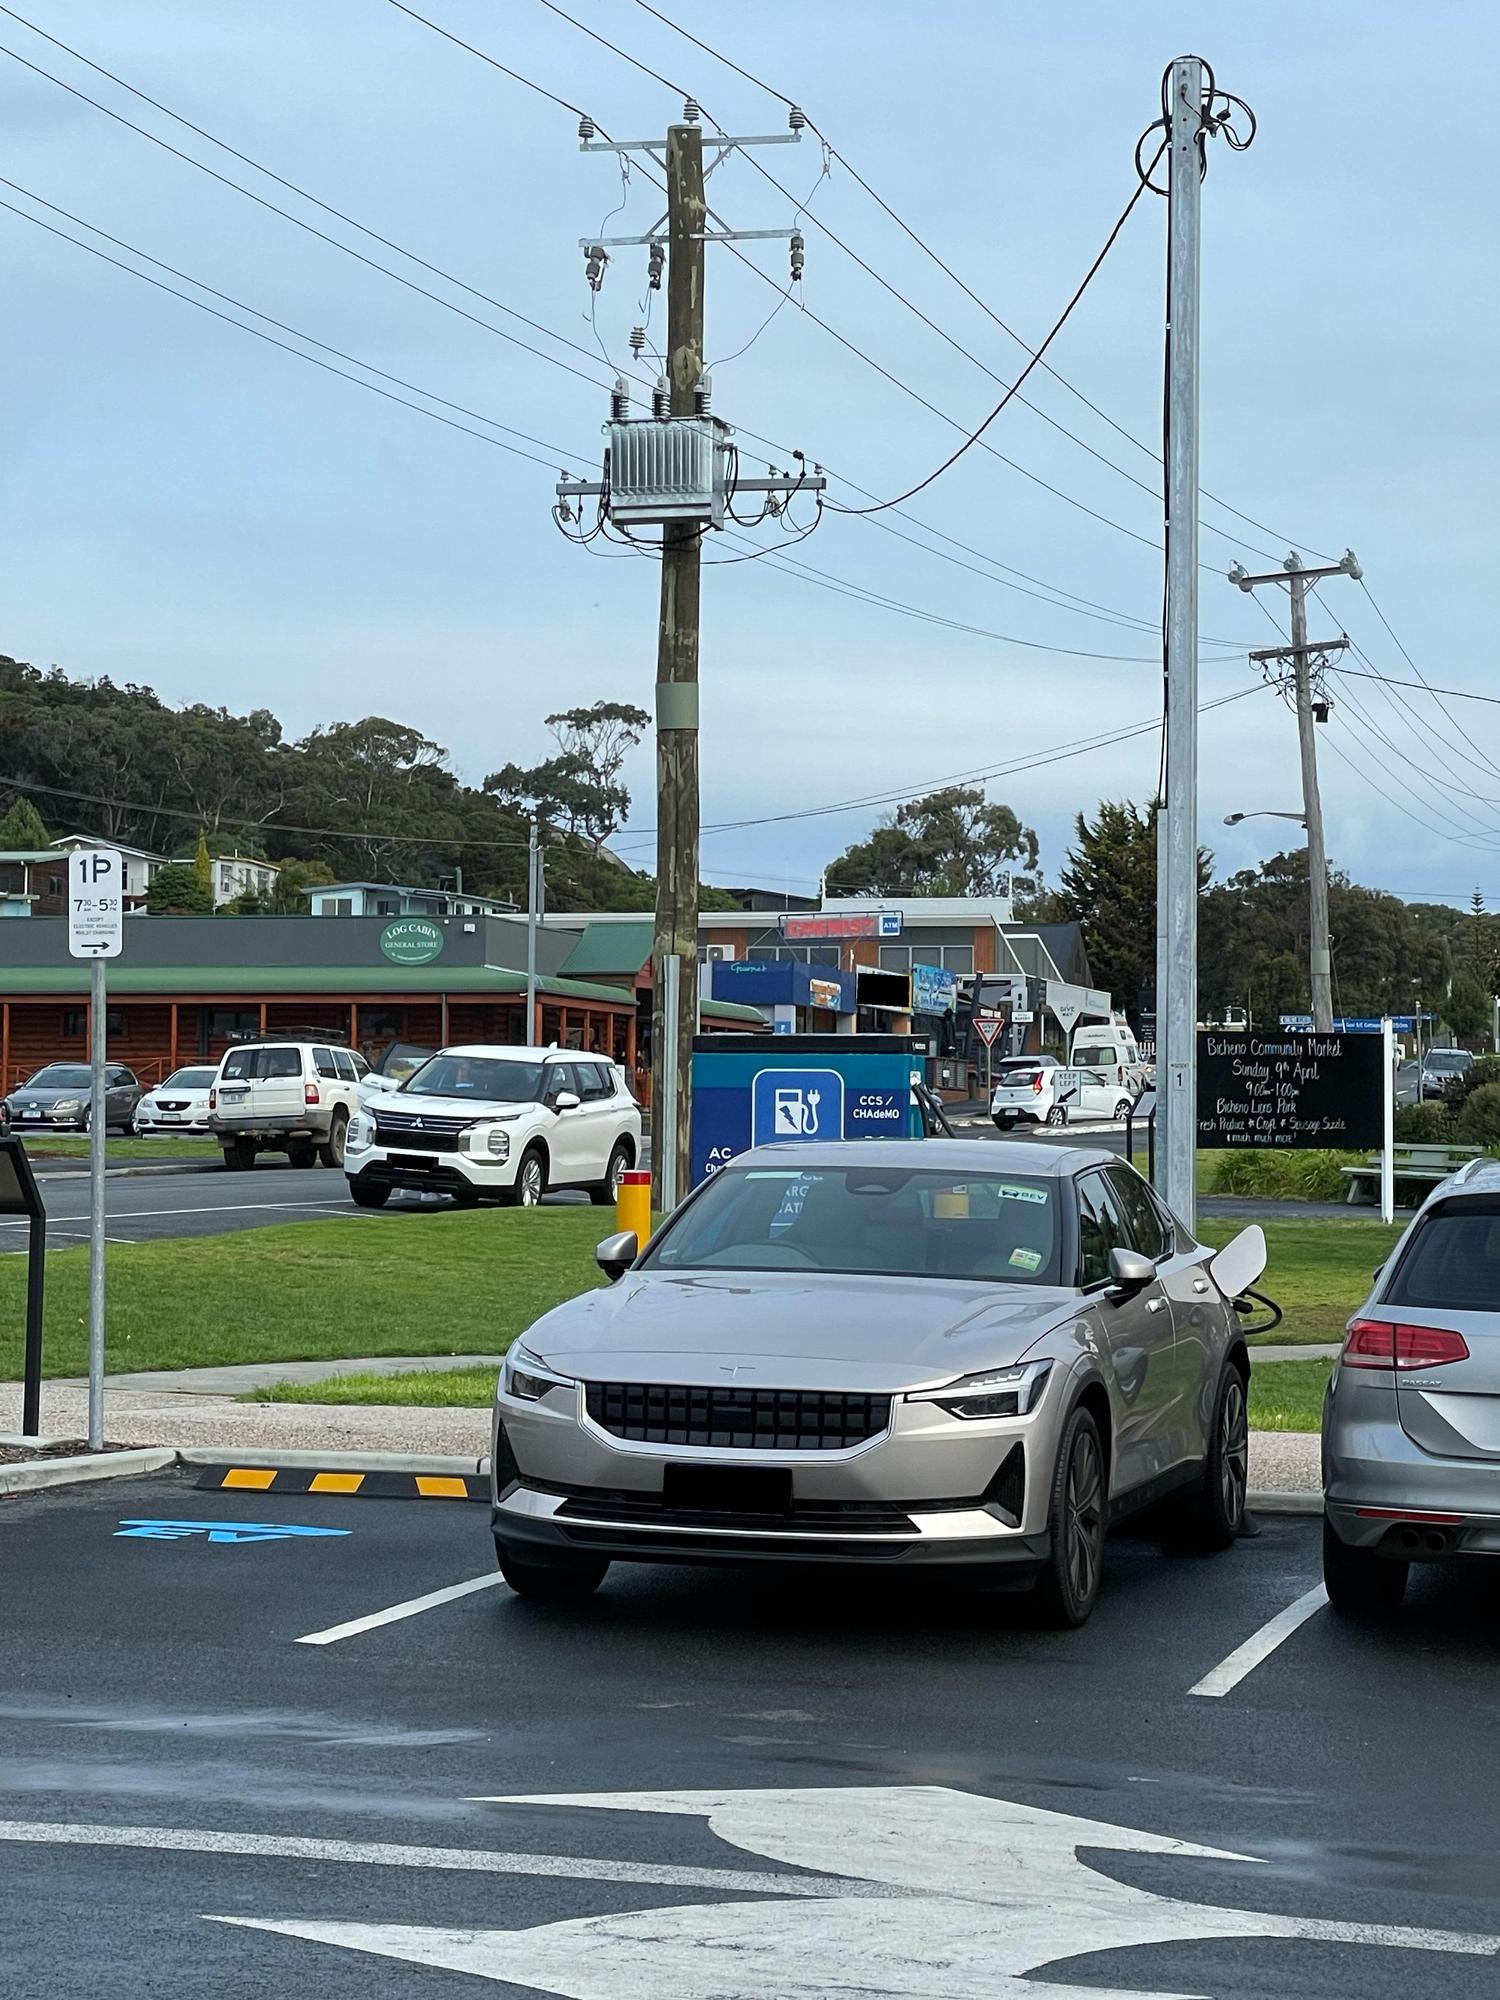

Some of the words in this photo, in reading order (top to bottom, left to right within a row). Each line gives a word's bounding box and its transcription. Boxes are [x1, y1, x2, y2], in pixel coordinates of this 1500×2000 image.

[80, 859, 111, 883] 1P
[386, 924, 407, 939] LOG
[408, 923, 439, 939] CABIN
[1207, 1037, 1247, 1056] Bicheno
[1250, 1038, 1304, 1060] Community
[1307, 1037, 1343, 1057] Market
[1176, 1072, 1182, 1087] 1
[1293, 1060, 1320, 1085] April
[859, 1096, 883, 1106] CCS
[1216, 1097, 1249, 1114] Bicheno
[1250, 1099, 1273, 1114] Lions
[1276, 1097, 1297, 1114] Park
[853, 1108, 900, 1120] CHAdeMO
[1219, 1116, 1245, 1131] Produce
[1256, 1116, 1277, 1136] Craft
[1289, 1116, 1321, 1135] Sausage
[1321, 1116, 1347, 1130] Sizzle
[1232, 1132, 1252, 1142] much
[1254, 1132, 1273, 1143] much
[709, 1147, 732, 1160] AC
[1021, 1192, 1045, 1200] BEV
